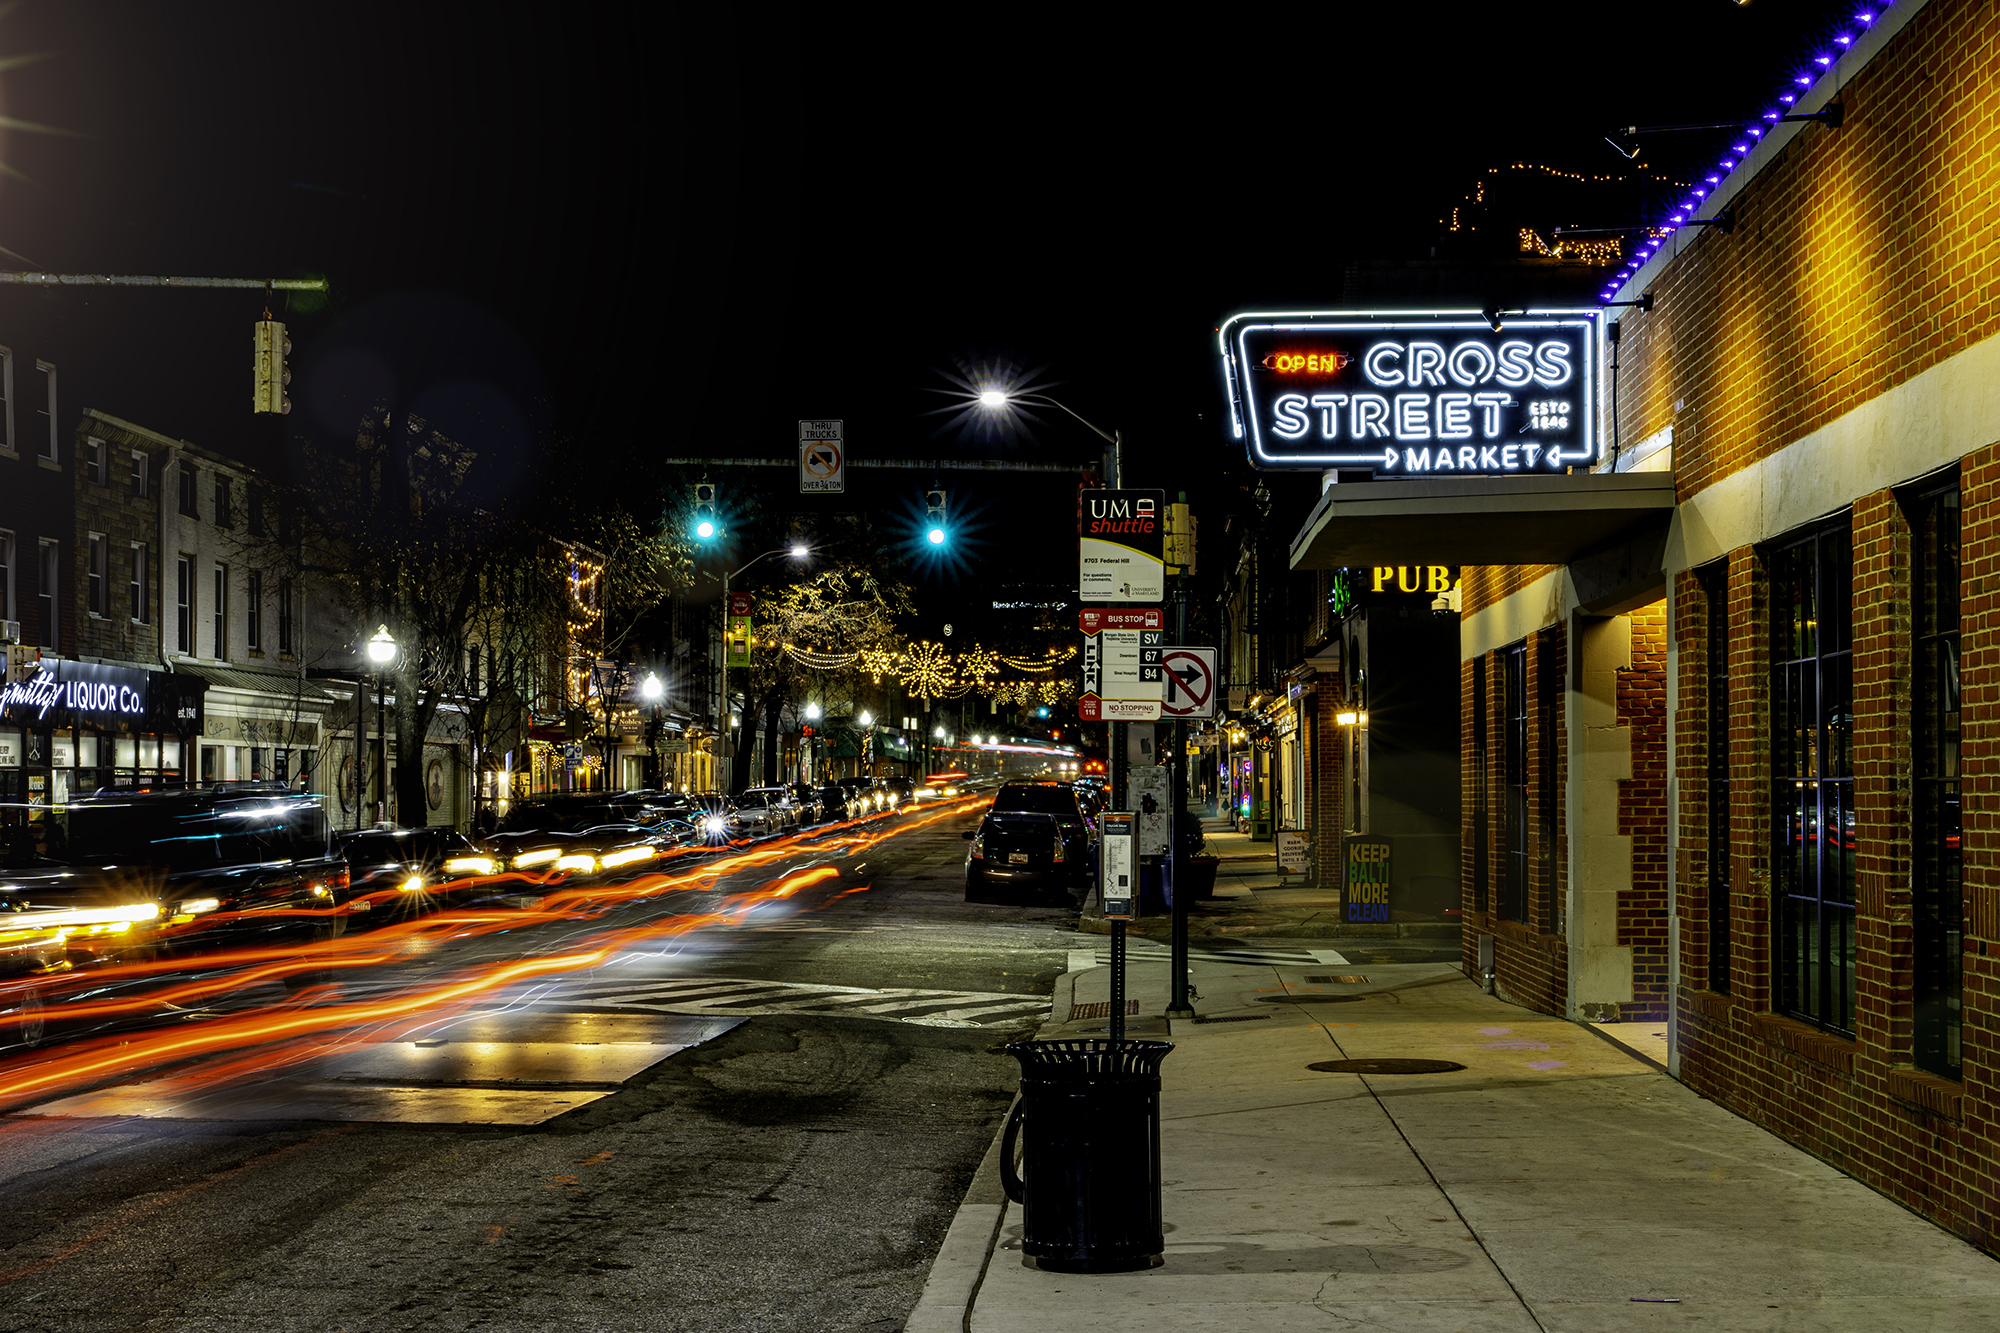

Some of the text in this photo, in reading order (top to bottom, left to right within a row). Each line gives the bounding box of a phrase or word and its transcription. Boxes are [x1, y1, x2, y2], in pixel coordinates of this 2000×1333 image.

[1277, 354, 1334, 372] OPEN
[1363, 341, 1572, 387] CROSS
[1271, 392, 1512, 440] STREET
[1530, 401, 1571, 415] ESTD
[810, 422, 832, 430] THRU
[1531, 416, 1569, 429] 1846
[805, 430, 837, 438] TRUCKS
[1405, 444, 1541, 471] MARKET
[803, 481, 819, 489] OVER
[829, 481, 841, 489] TON
[1090, 499, 1131, 518] UM
[1089, 517, 1155, 533] shuttle
[1371, 565, 1450, 592] PUB
[1108, 615, 1123, 623] BUS
[1125, 615, 1144, 623] STOP
[1144, 633, 1159, 644] SV
[1145, 651, 1158, 662] 67
[1144, 668, 1158, 680] 94
[0, 671, 144, 720] mitty's LIQUOR Co.
[177, 707, 186, 718] est.
[1350, 844, 1390, 862] KEEP
[1349, 862, 1389, 883] BALTI
[1348, 882, 1389, 904] MORE
[1348, 903, 1389, 921] CLEAN
